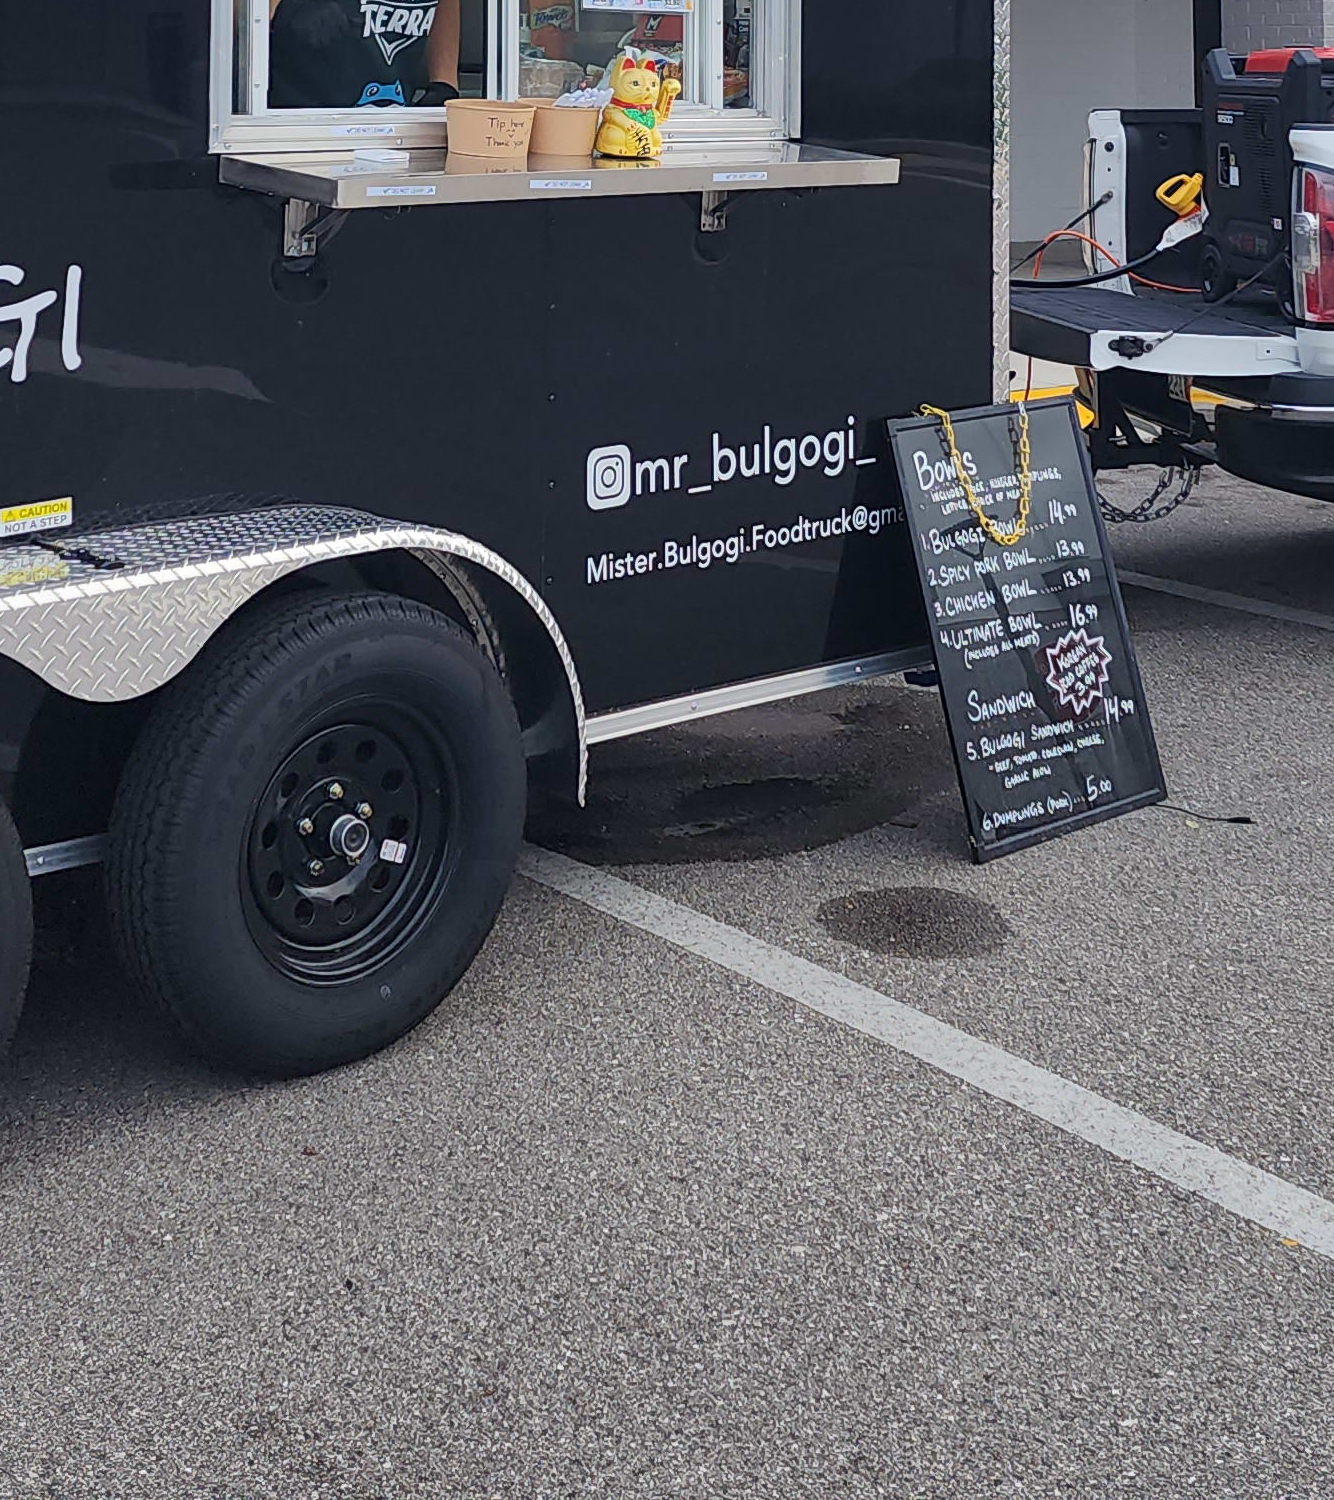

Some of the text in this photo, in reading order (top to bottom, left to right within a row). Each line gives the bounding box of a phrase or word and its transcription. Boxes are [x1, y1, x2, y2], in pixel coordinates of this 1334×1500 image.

[360, 4, 436, 37] TERRA
[487, 117, 506, 132] Tip
[635, 415, 876, 495] mr_bulgogi_
[913, 451, 977, 490] BOWS
[4, 514, 67, 534] NOT A STEP
[19, 501, 68, 519] CAUTION
[1048, 499, 1077, 525] 14.99
[973, 556, 1000, 578] PORK
[1002, 547, 1037, 571] BOWL
[1056, 539, 1085, 557] 13.99
[1001, 578, 1038, 604] BOWL
[1062, 567, 1091, 588] 13.99
[1007, 612, 1043, 633] BOWL
[1069, 603, 1098, 628] 16.99
[1055, 642, 1087, 671] KOREAN
[1074, 671, 1096, 697] 3.99
[967, 689, 1037, 722] SANDWICH
[1031, 720, 1074, 741] SANDWICH
[1104, 696, 1134, 724] 14.99
[1086, 774, 1112, 802] 5.00
